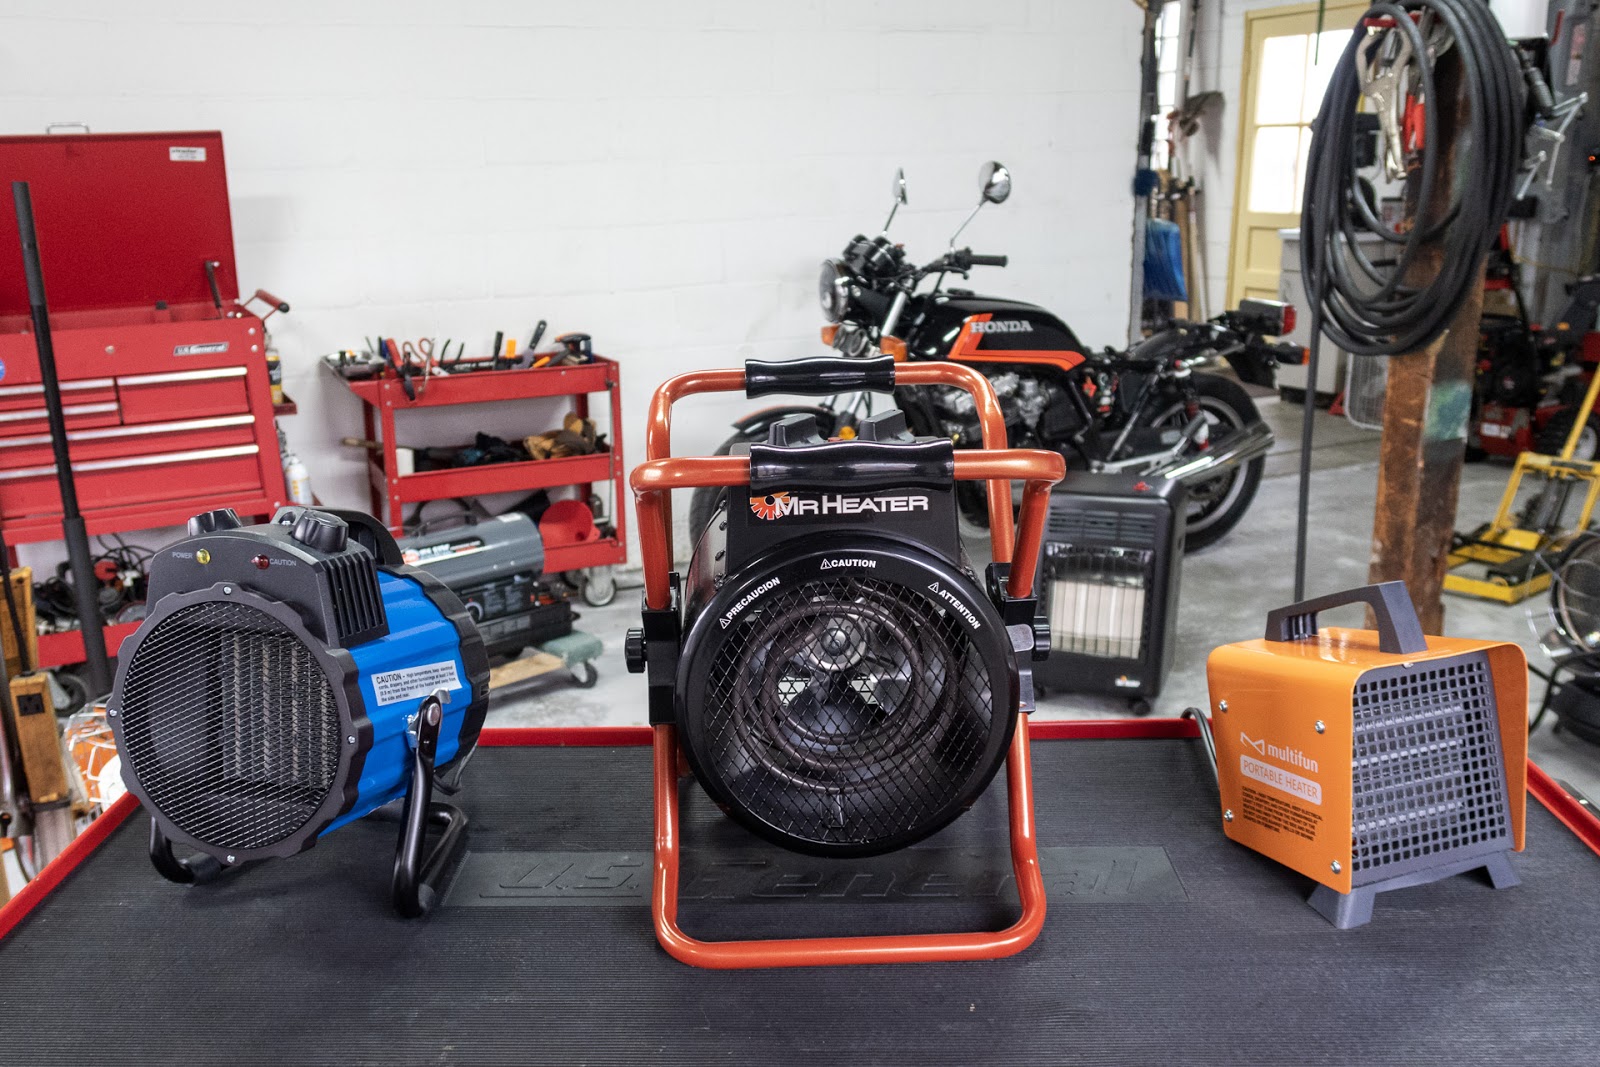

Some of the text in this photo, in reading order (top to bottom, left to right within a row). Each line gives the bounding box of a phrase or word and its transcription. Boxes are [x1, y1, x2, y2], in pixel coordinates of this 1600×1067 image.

[970, 320, 1033, 333] HONDA
[822, 495, 928, 514] HEATER
[270, 558, 296, 566] CAUTION
[831, 559, 876, 568] CAUTION
[726, 577, 780, 620] PRECAUCION
[939, 590, 981, 630] ATTENTION
[376, 673, 402, 684] CAUTION
[1268, 744, 1318, 773] multifun
[1243, 760, 1318, 798] PORTABLE HEATER
